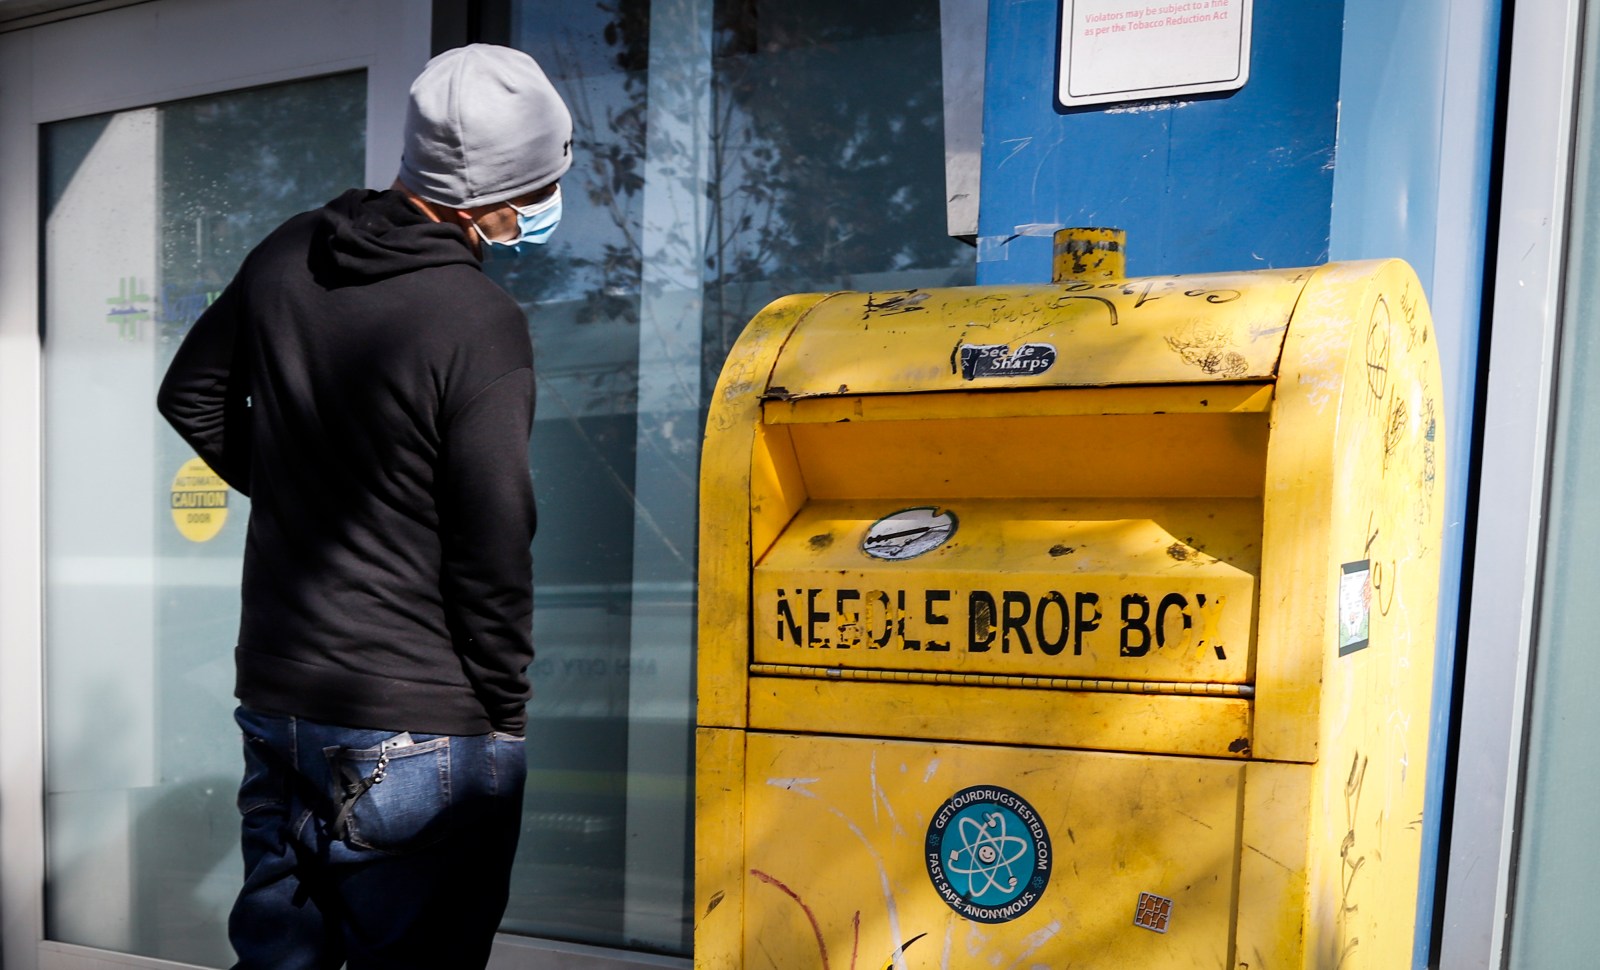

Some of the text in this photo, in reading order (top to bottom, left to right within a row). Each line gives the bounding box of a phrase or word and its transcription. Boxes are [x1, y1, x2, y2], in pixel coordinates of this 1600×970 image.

[1084, 10, 1228, 37] as per the Tobacco Reduction Act
[1085, 12, 1123, 23] Violators
[1125, 9, 1144, 20] may
[1145, 5, 1156, 16] be
[1158, 2, 1191, 16] subject
[1192, 1, 1201, 10] to
[1211, 0, 1229, 8] fine
[990, 357, 1049, 372] Sharps
[172, 491, 226, 508] CAUTION
[187, 513, 211, 524] DOOR
[777, 588, 1227, 661] NEEDLE DROP BOX
[935, 789, 1048, 870] GETYOURDRUGSTESTED.COM
[929, 852, 1037, 920] FAST. SAFE. ANONYMOUS.
